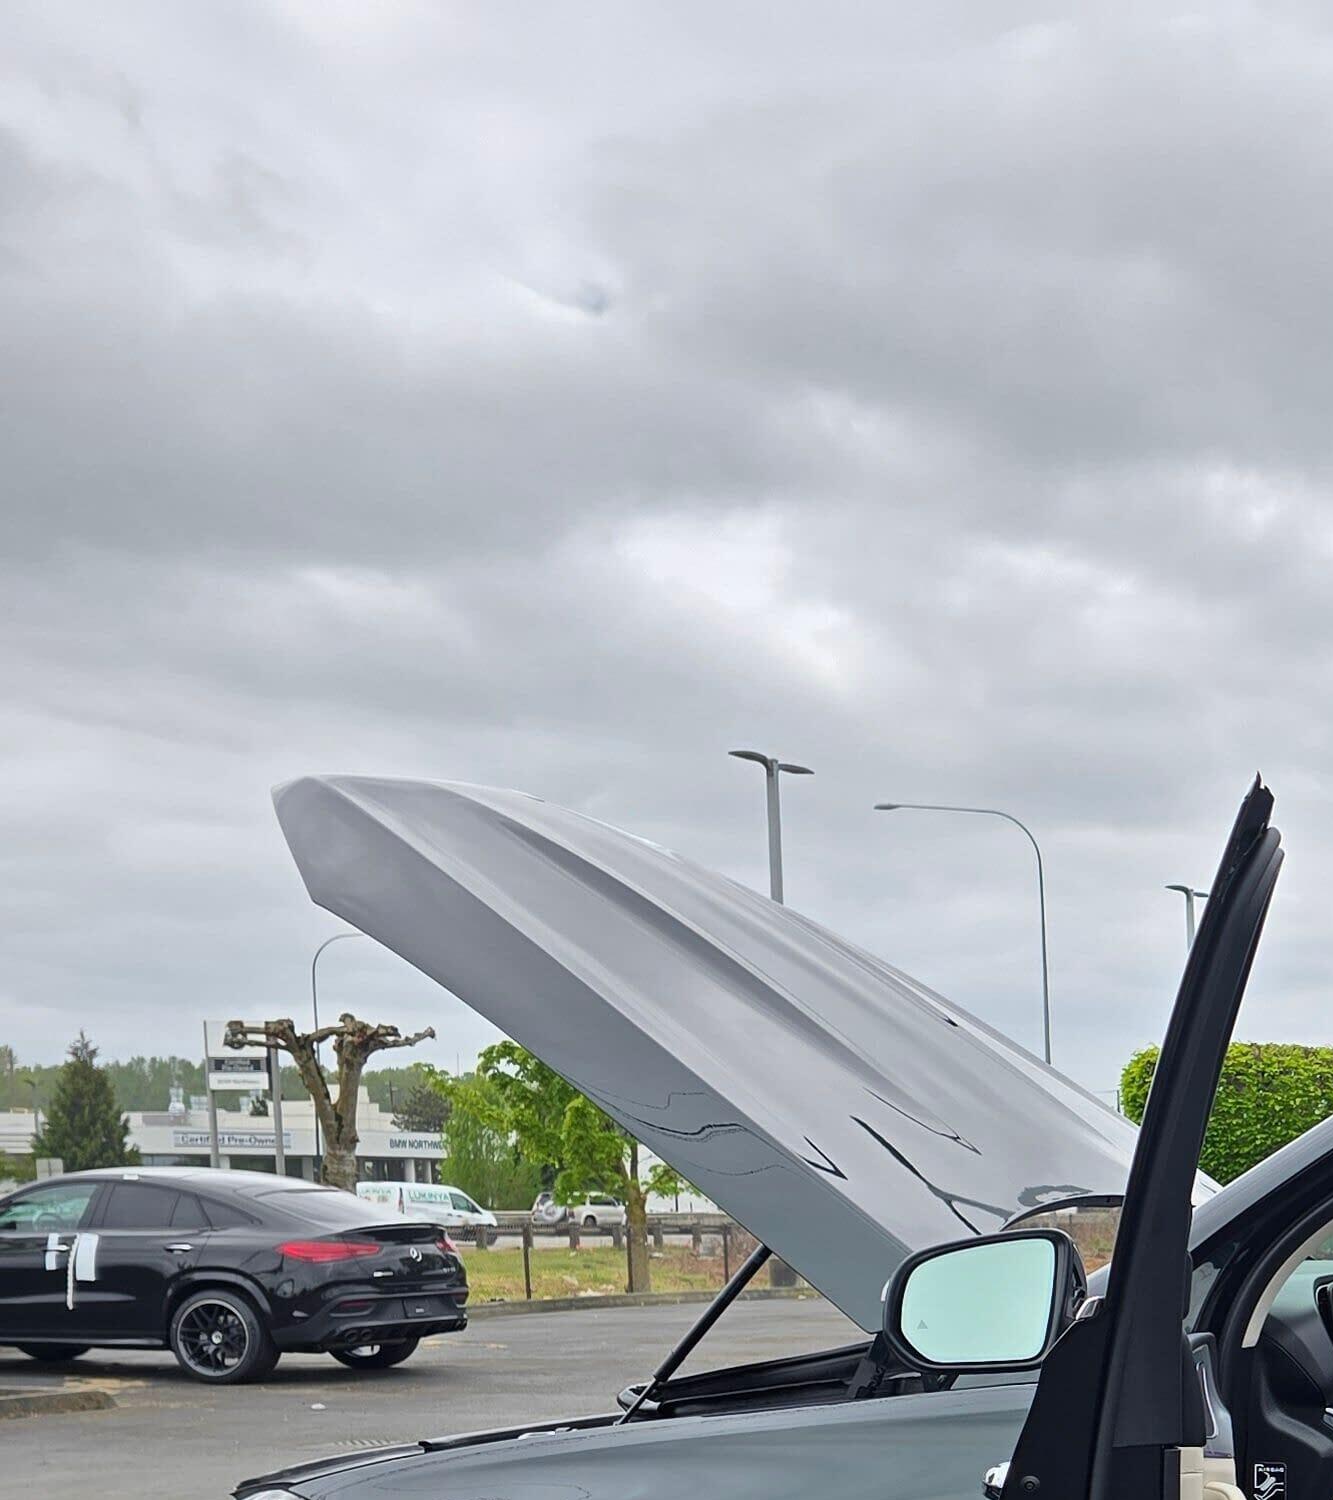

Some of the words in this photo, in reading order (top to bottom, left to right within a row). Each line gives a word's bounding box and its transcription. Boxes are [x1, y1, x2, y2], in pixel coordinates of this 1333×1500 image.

[181, 1136, 225, 1144] Certifd
[227, 1135, 276, 1146] Pre-Owne
[389, 1138, 407, 1149] BMW
[408, 1139, 443, 1150] NORTHWE
